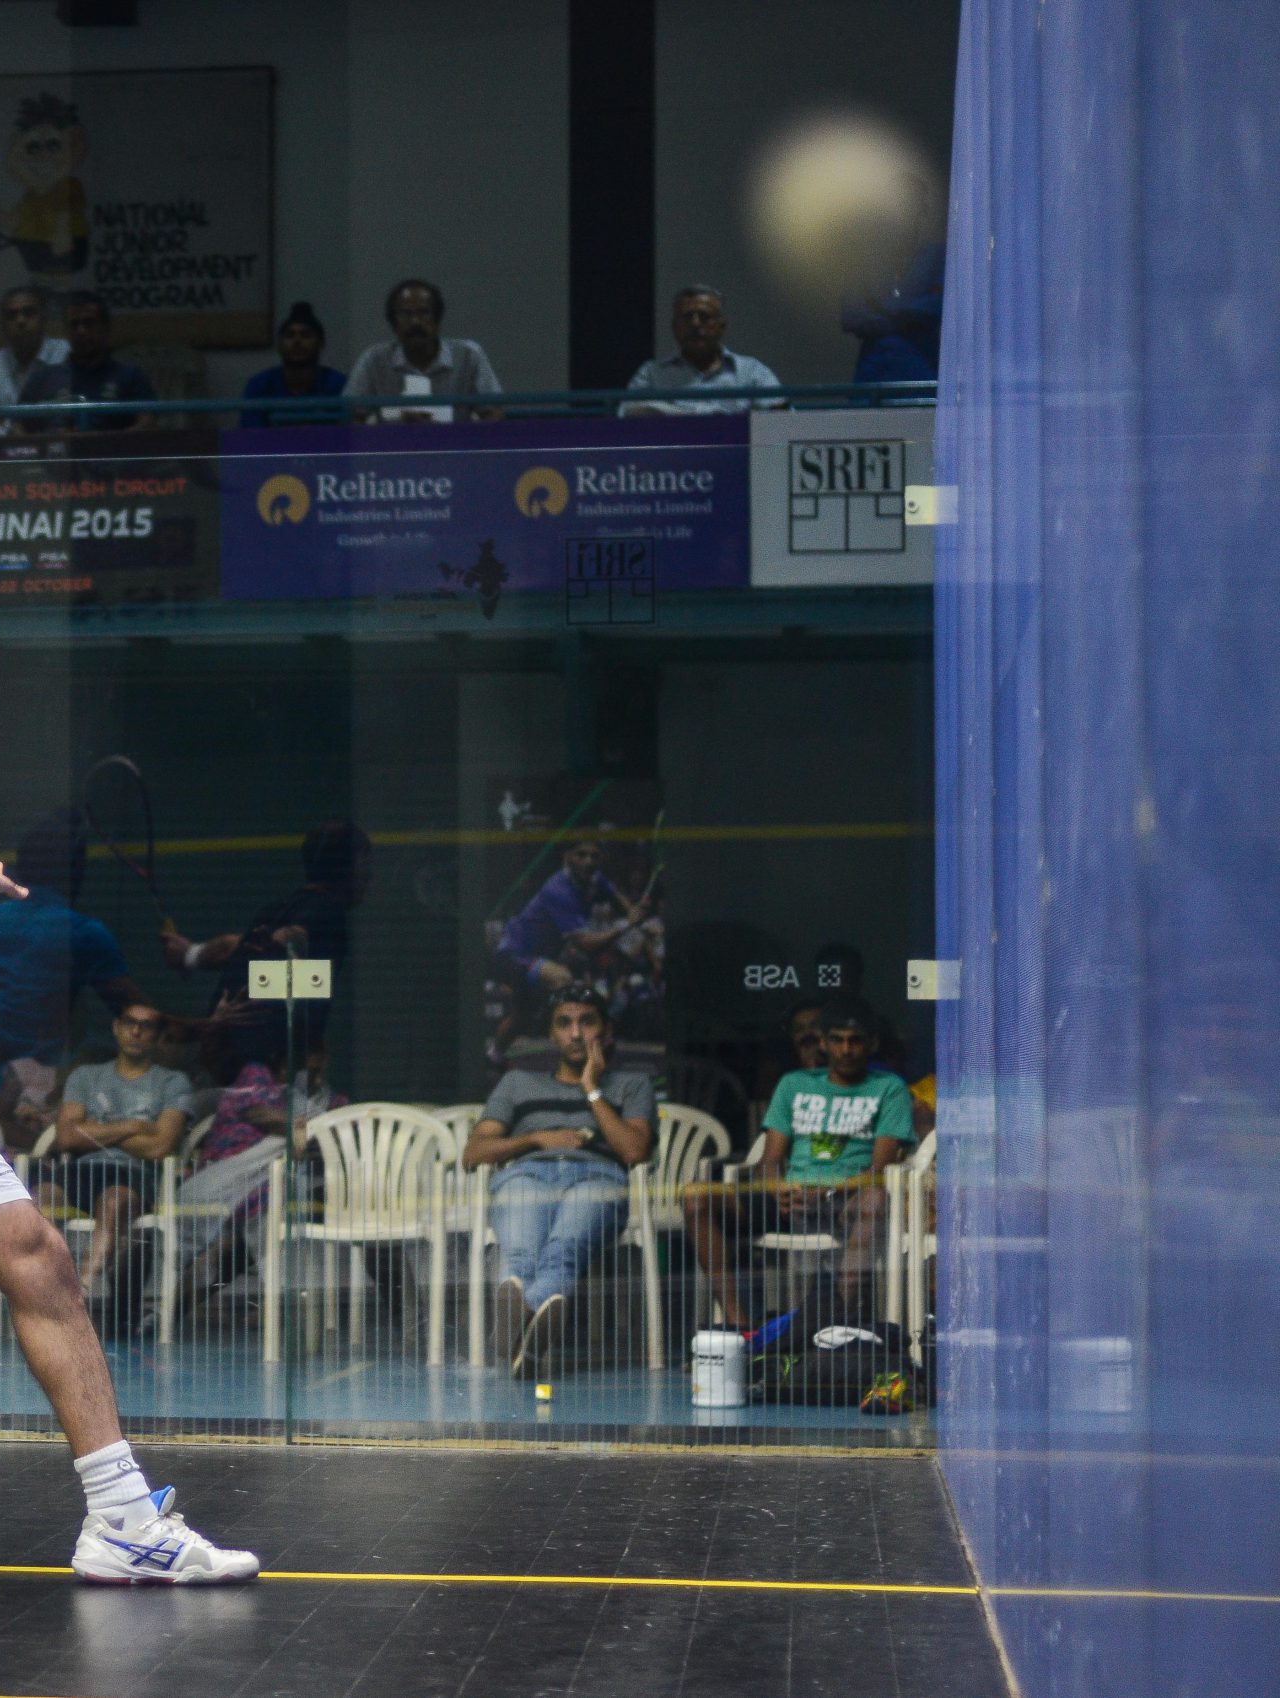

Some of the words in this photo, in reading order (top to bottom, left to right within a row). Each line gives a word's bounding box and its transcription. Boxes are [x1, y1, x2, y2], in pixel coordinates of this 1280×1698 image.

[93, 201, 208, 227] NATIONAL
[94, 229, 188, 255] JUNIOR
[94, 253, 257, 283] DEVELOPMENT
[95, 283, 225, 308] PROGRAM
[575, 465, 714, 495] Reliance
[798, 445, 892, 491] SRFi
[24, 480, 107, 501] SQUASH
[113, 478, 187, 497] CIRCUIT
[316, 472, 453, 503] Reliance
[318, 508, 391, 524] Industries
[395, 506, 451, 522] Limited
[577, 501, 650, 517] Industries
[655, 499, 713, 516] Limited
[69, 507, 154, 539] 2015
[665, 525, 693, 539] Life
[23, 577, 92, 593] OCTOBER
